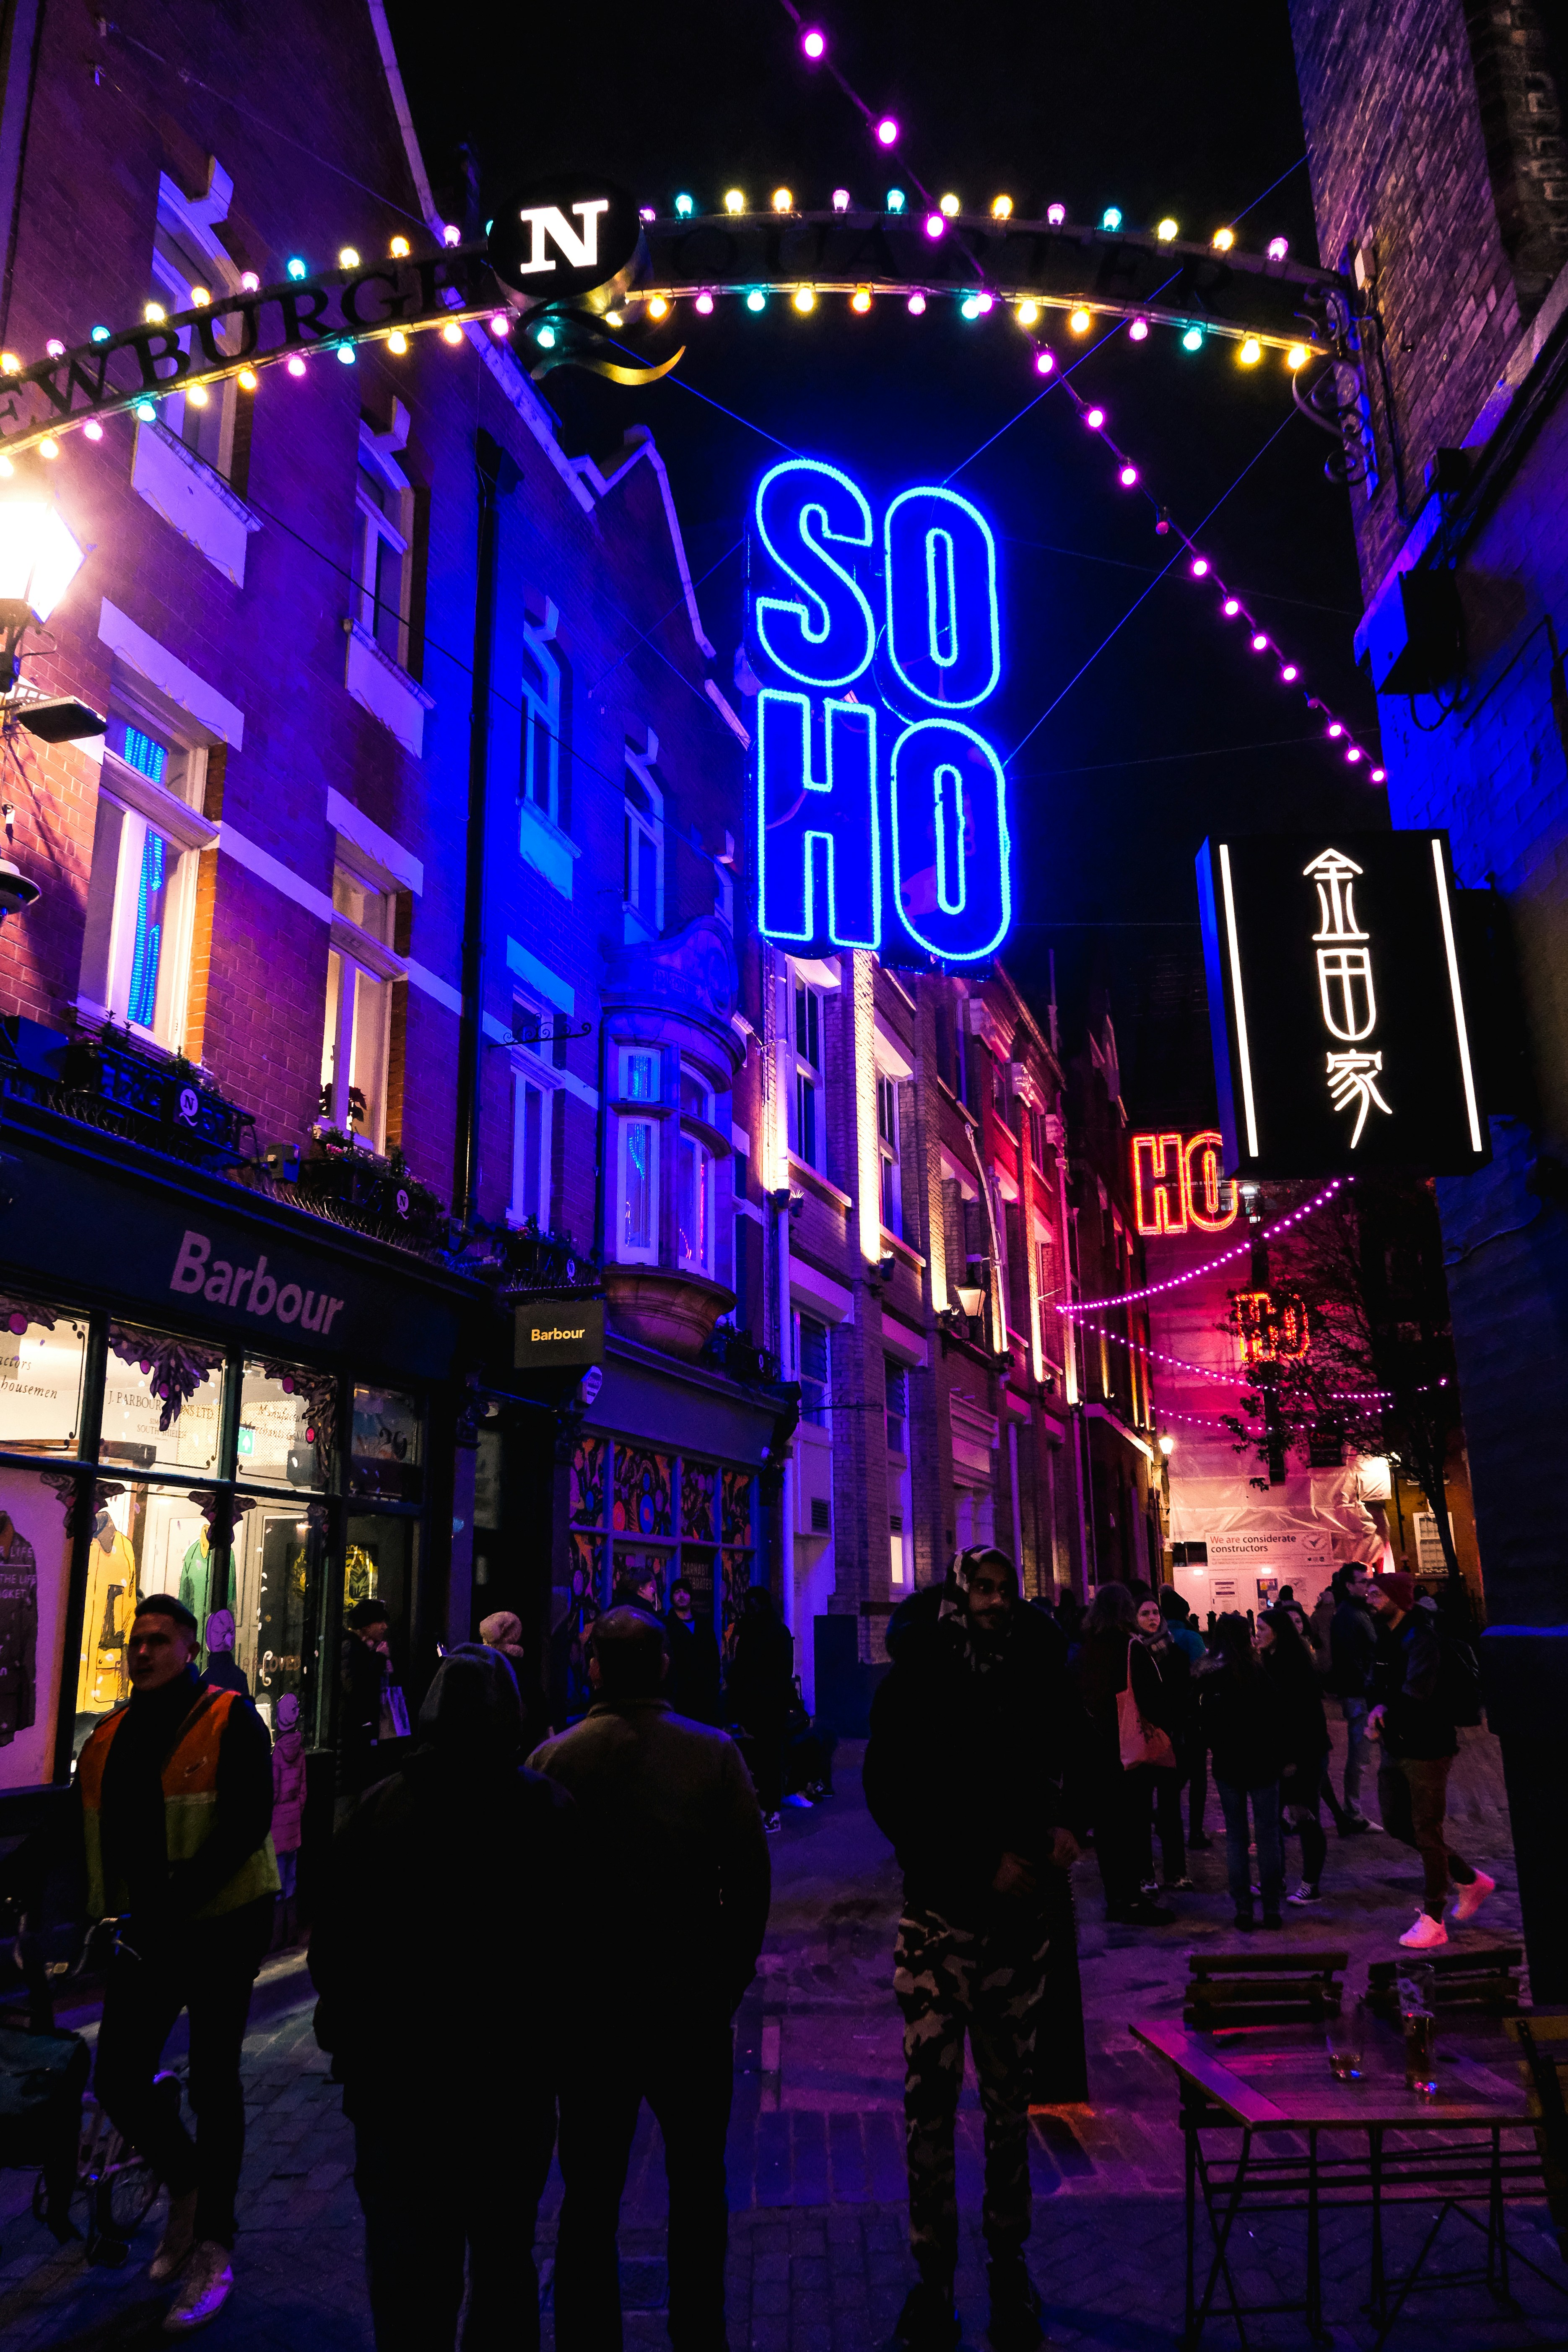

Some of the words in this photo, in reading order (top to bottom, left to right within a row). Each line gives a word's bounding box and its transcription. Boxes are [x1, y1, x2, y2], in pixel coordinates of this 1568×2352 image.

[520, 200, 608, 274] N
[755, 458, 1000, 709] SO
[756, 688, 1011, 962] HO
[1303, 848, 1393, 1149] 金田家
[1132, 1132, 1238, 1236] HO
[169, 1230, 345, 1335] Barbour
[531, 1327, 585, 1341] Barbour
[1, 1375, 58, 1399] housemen
[117, 1391, 162, 1411] BARBOUR
[1243, 1534, 1296, 1543] considerate
